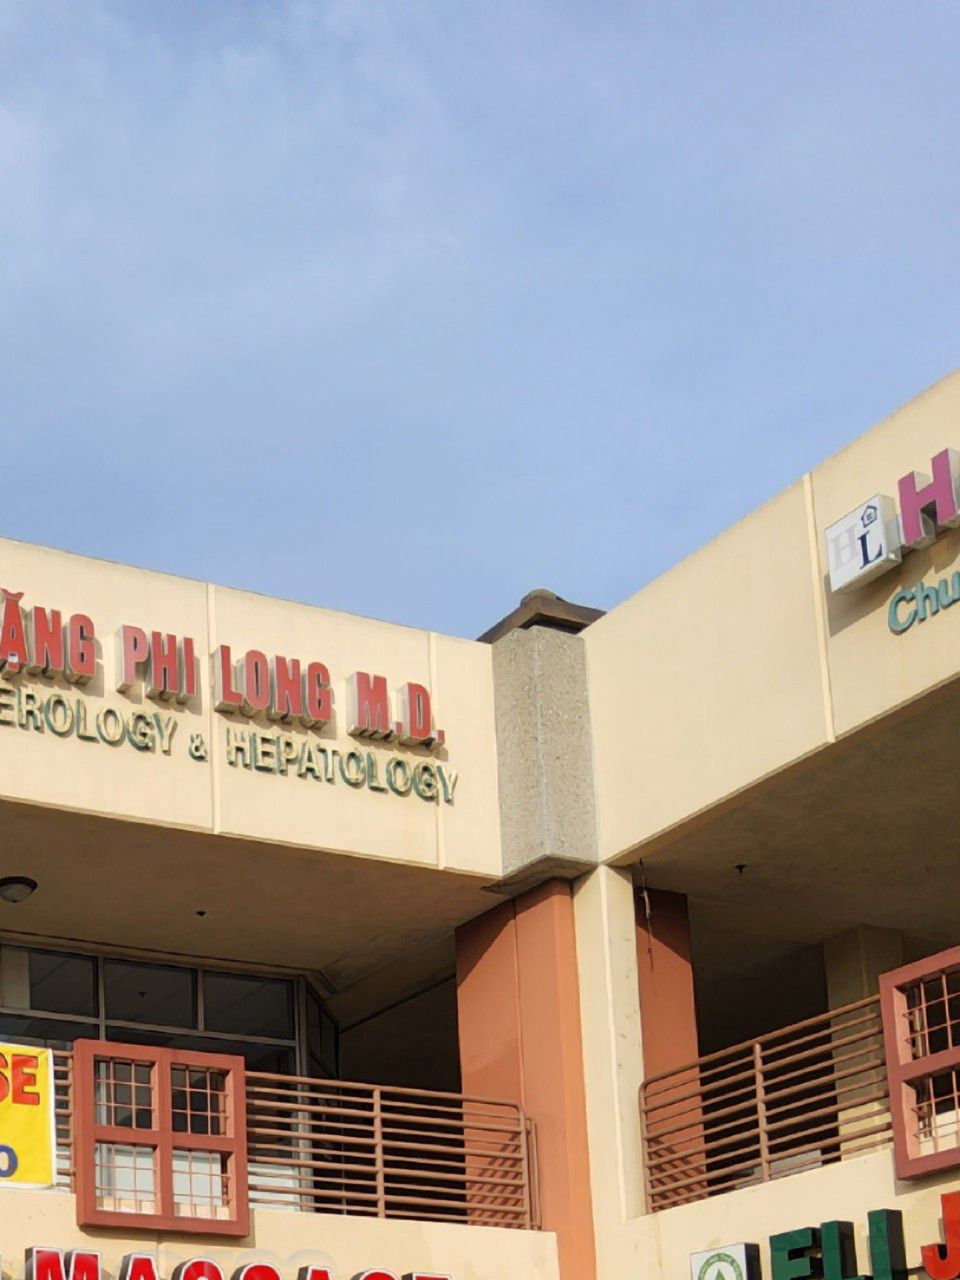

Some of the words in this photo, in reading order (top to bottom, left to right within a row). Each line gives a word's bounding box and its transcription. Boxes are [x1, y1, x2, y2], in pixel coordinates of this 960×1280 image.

[119, 624, 197, 700] PHI
[214, 645, 333, 725] LONG
[350, 671, 446, 746] M.D.
[190, 732, 208, 761] &
[225, 726, 459, 804] HEPATOLOGY
